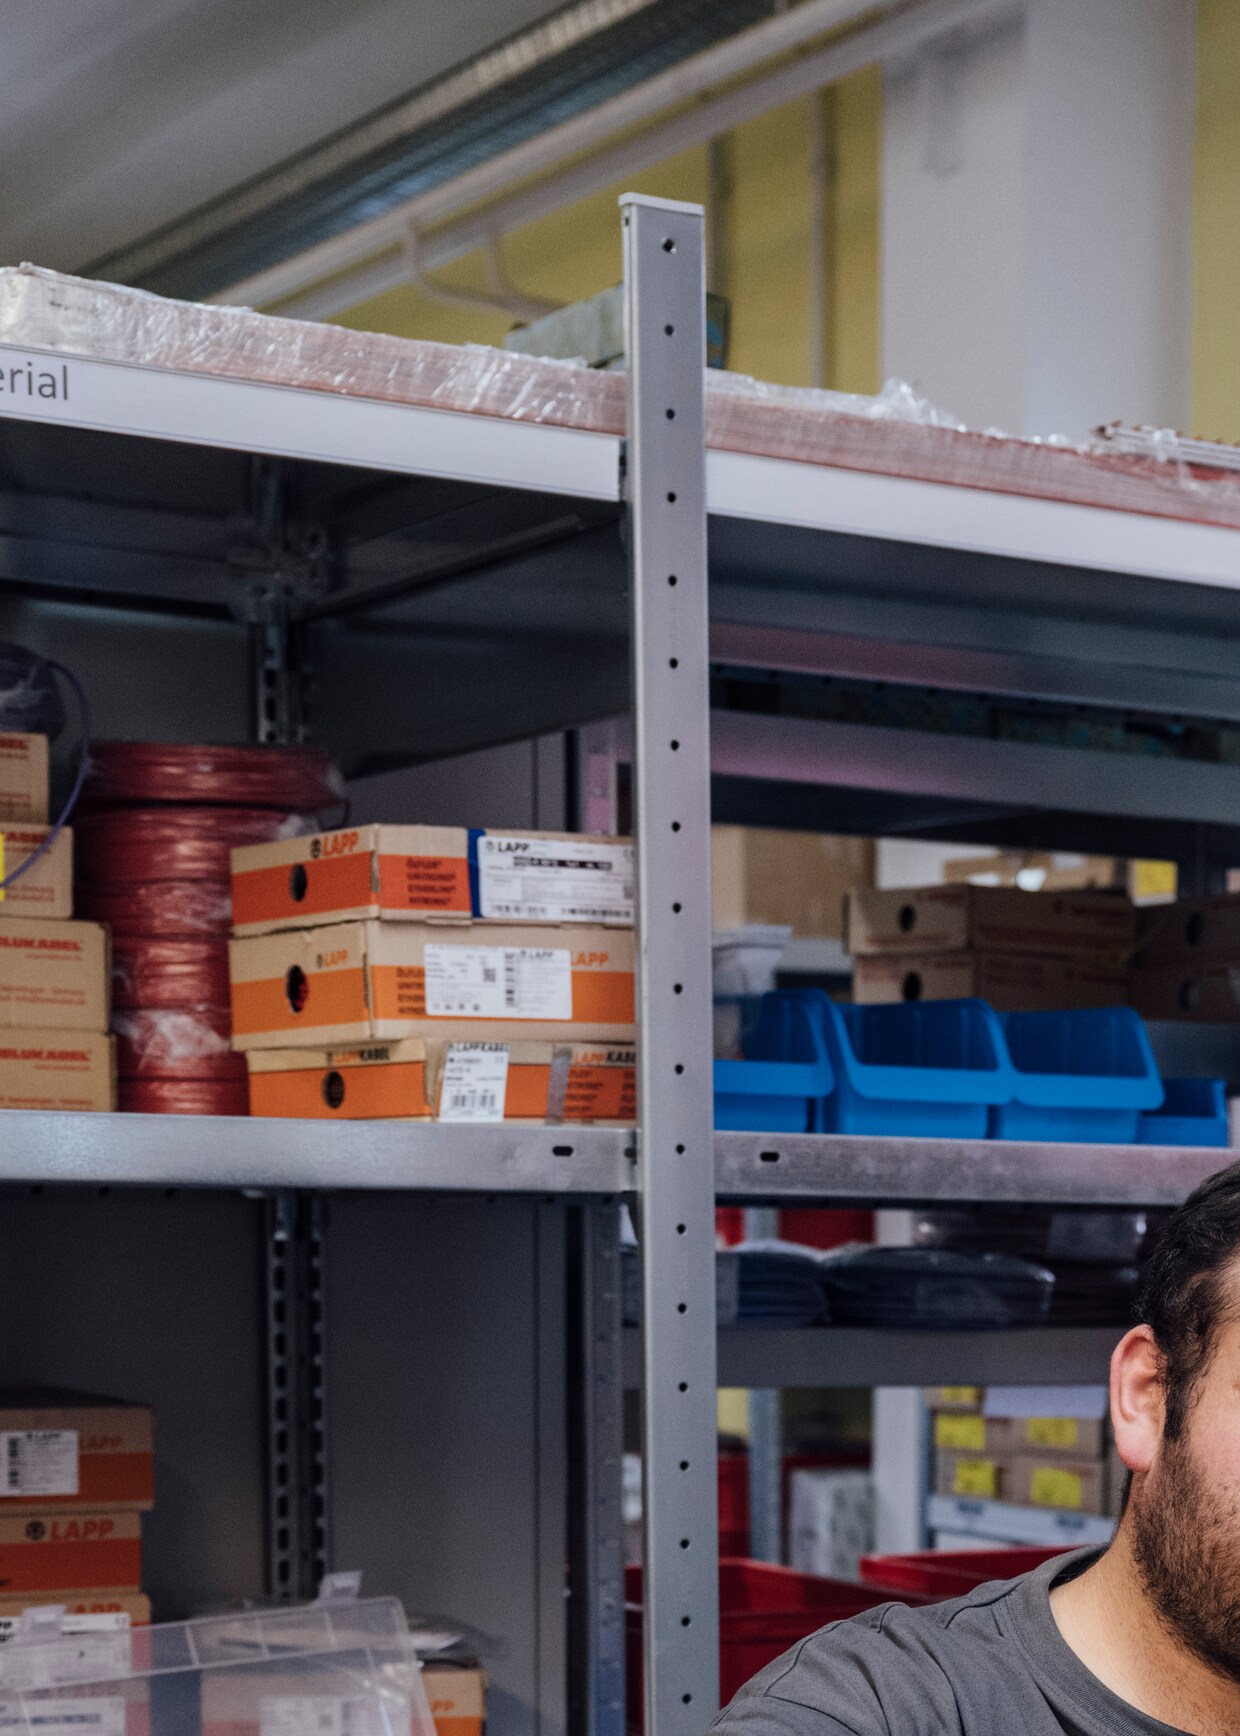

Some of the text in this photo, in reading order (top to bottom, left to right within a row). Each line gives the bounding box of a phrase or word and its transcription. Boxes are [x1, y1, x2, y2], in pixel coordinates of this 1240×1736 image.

[0, 361, 68, 401] rial
[322, 832, 359, 856] LAPP
[498, 842, 530, 852] LAPP
[571, 952, 609, 967] APP
[51, 1518, 115, 1543] LAPP
